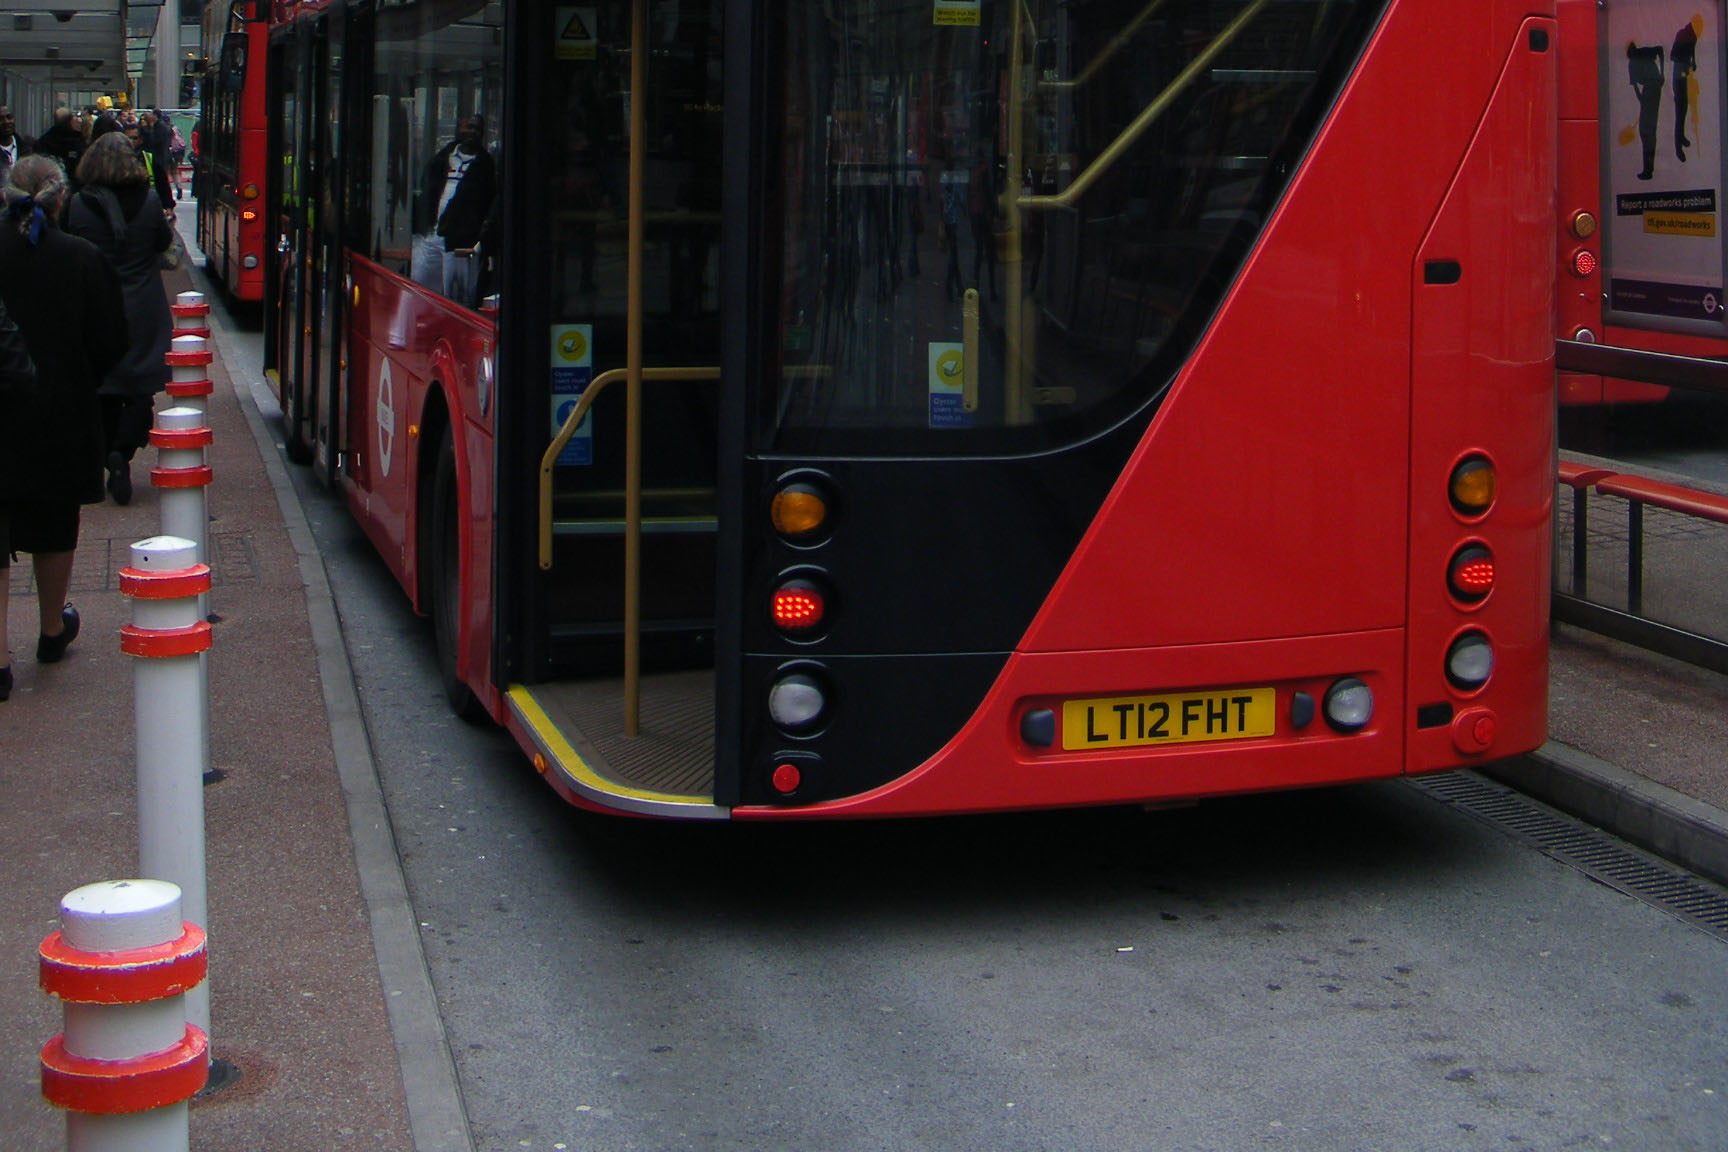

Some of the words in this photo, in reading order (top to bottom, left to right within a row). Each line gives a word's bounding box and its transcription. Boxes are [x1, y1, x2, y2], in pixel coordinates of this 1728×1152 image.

[1621, 200, 1642, 211] Report
[1648, 198, 1682, 209] roadworks
[1683, 196, 1712, 208] problem
[1086, 701, 1170, 743] LT12
[1182, 696, 1253, 736] FHT
